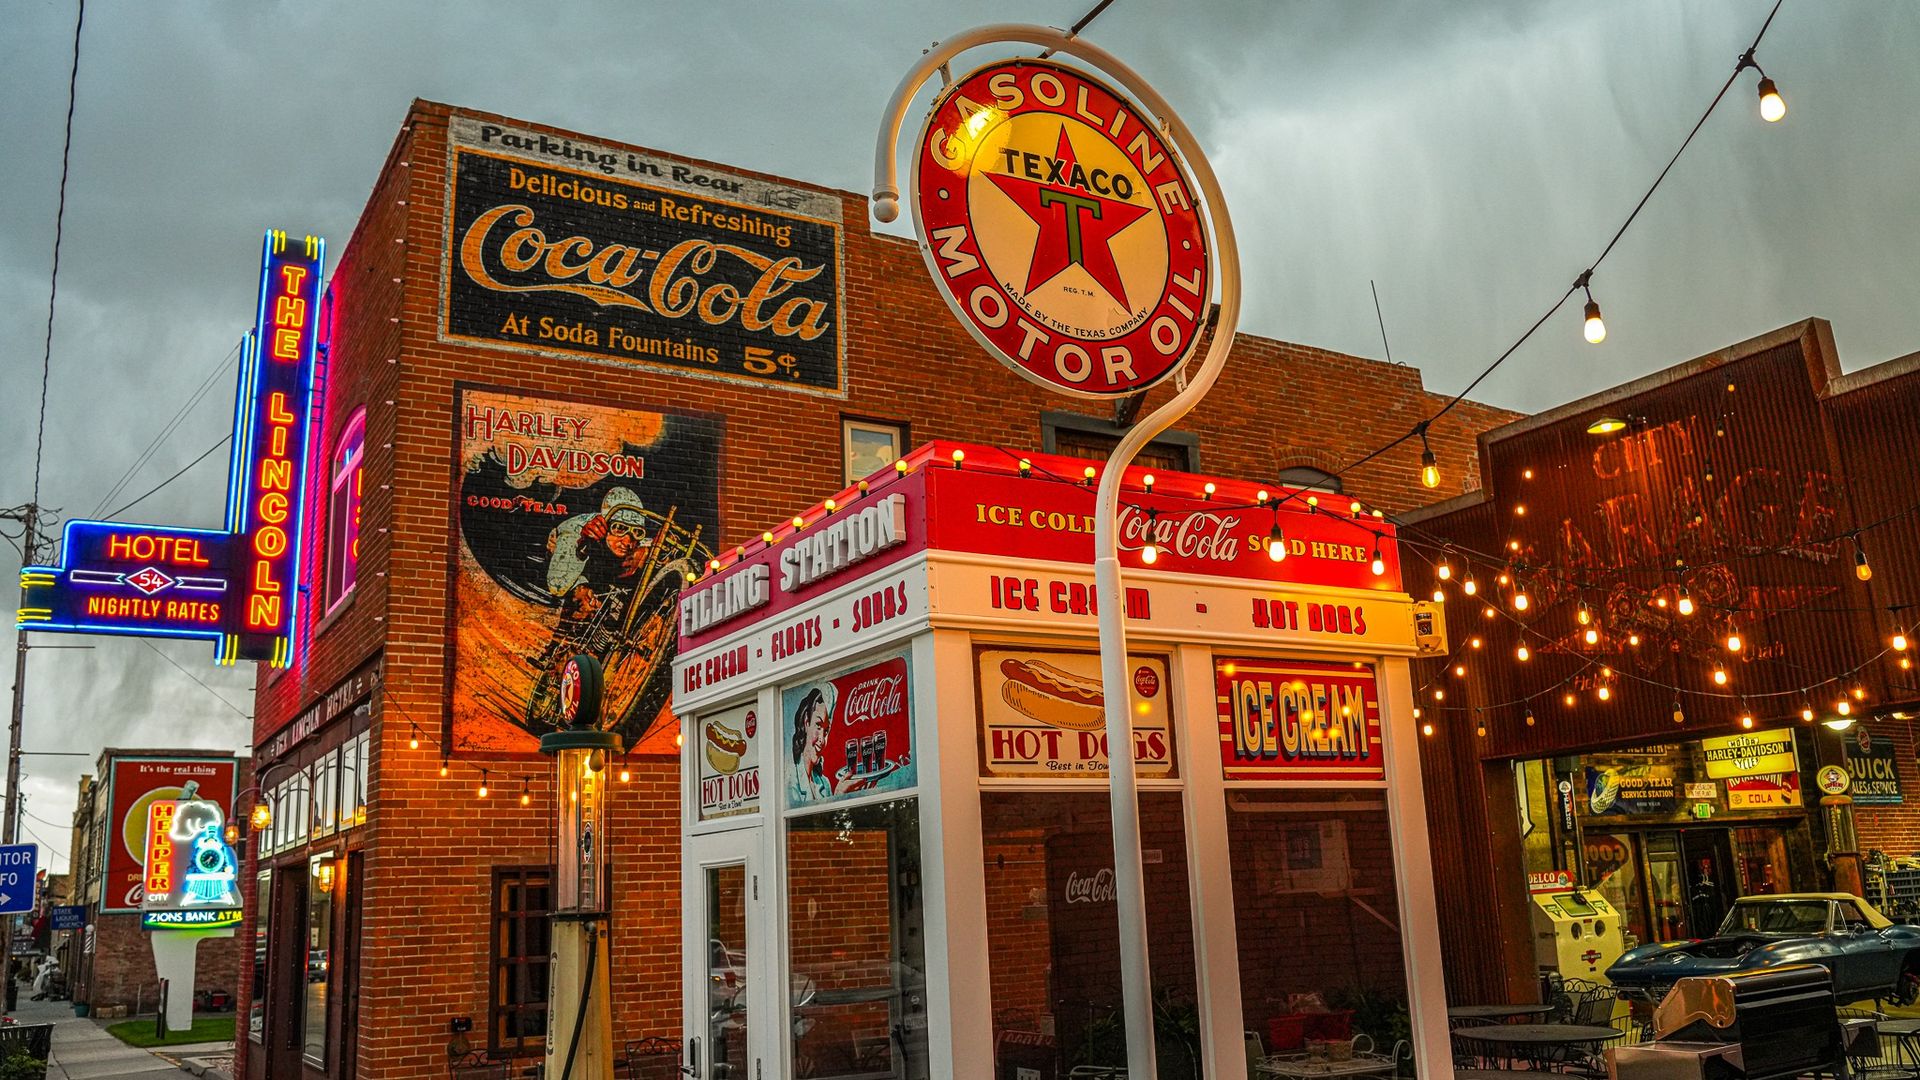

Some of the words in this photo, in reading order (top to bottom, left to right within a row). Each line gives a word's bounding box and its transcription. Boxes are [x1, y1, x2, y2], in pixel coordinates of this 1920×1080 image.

[481, 125, 618, 174] Parking
[627, 155, 663, 177] in
[671, 166, 744, 194] Rear
[931, 72, 1189, 215] GASOLINE
[1000, 148, 1133, 200] TEXACO
[509, 167, 629, 210] Delicious
[633, 200, 655, 213] and
[660, 198, 792, 247] Refreshing
[461, 204, 831, 341] Coca-Cola
[1063, 286, 1080, 295] REG.
[273, 265, 306, 360] THE
[931, 225, 1139, 385] MOTOR
[1004, 282, 1032, 312] MADE
[1034, 309, 1049, 323] BY
[1051, 318, 1071, 334] THE
[1073, 327, 1106, 339] TEXAS
[1109, 306, 1149, 336] COMPANY
[1150, 268, 1201, 356] OIL
[501, 312, 530, 335] At
[539, 316, 599, 347] Soda
[608, 329, 719, 365] Fountains
[467, 405, 591, 442] HARLEY
[506, 442, 645, 480] DAVIDSON
[1593, 415, 1697, 481] CITY
[250, 392, 294, 627] LINCOLN
[110, 534, 209, 565] HOTEL
[976, 503, 1024, 527] ICE
[1029, 509, 1096, 534] COLD
[1117, 504, 1241, 562] Coca-Cola
[1310, 541, 1368, 563] HERE
[138, 572, 161, 590] 54
[680, 562, 771, 638] FILLING
[780, 492, 907, 593] STATION
[88, 597, 162, 618] NIGHTLY
[166, 601, 220, 621] RATES
[991, 575, 1040, 612] ICE
[1049, 580, 1152, 621] CREM
[1251, 597, 1299, 631] HOT
[1306, 602, 1367, 636] DOGS
[684, 666, 702, 695] ICE
[705, 644, 749, 687] CREAM
[771, 613, 823, 664] FLOATS
[851, 579, 909, 634] SODAS
[326, 679, 354, 721] HOTEL
[844, 673, 904, 727] Coca-Cola
[857, 677, 880, 691] DRINK
[1230, 678, 1278, 760] ICE
[1278, 680, 1371, 760] CREAM
[992, 729, 1063, 761] HOT
[1706, 742, 1785, 761] HARLEY-DAVIDSON
[1730, 736, 1760, 748] MOTOR
[140, 765, 154, 774] It's
[156, 765, 171, 774] the
[173, 765, 191, 774] real
[193, 765, 217, 775] thing
[1075, 762, 1085, 770] in
[1088, 761, 1110, 771] Tow
[1620, 778, 1644, 788] GOOD
[1648, 777, 1673, 788] YEAR
[1846, 757, 1896, 780] BUICK
[703, 777, 725, 806] HOT
[728, 769, 760, 801] DOGS
[1621, 790, 1647, 799] SERVICE
[1648, 789, 1674, 798] STATION
[1748, 793, 1774, 804] COLA
[149, 804, 175, 892] HELPER
[148, 893, 169, 902] CITY
[1528, 872, 1555, 884] DELCO
[148, 912, 184, 923] ZIONS
[185, 911, 217, 922] BANK
[217, 910, 243, 921] ATM
